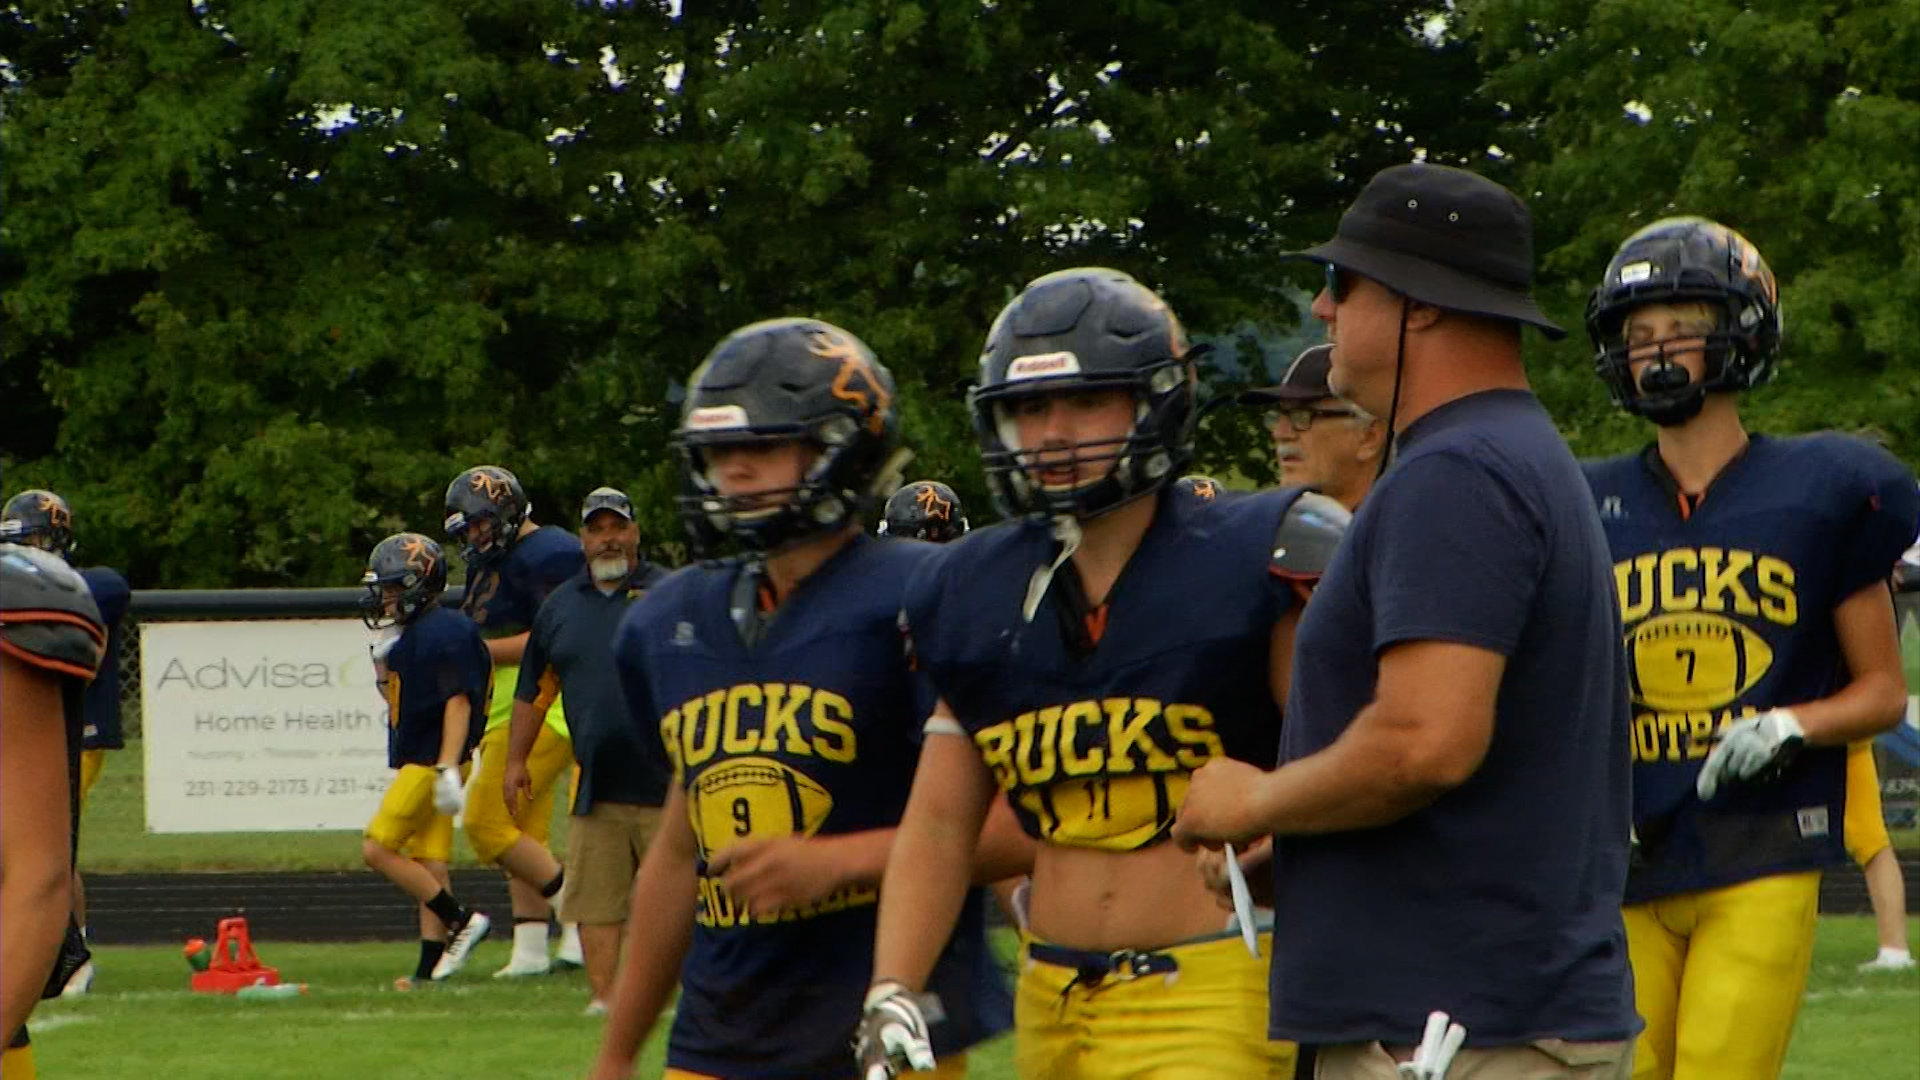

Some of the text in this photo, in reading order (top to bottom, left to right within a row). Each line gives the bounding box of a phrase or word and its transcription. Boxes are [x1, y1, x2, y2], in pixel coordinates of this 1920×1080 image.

[1613, 547, 1798, 626] UCKS
[1675, 648, 1696, 684] 7
[194, 711, 276, 734] Home
[285, 707, 372, 731] Health
[185, 778, 309, 797] 231-229-2173
[327, 776, 392, 795] 231-42
[732, 797, 751, 837] 9
